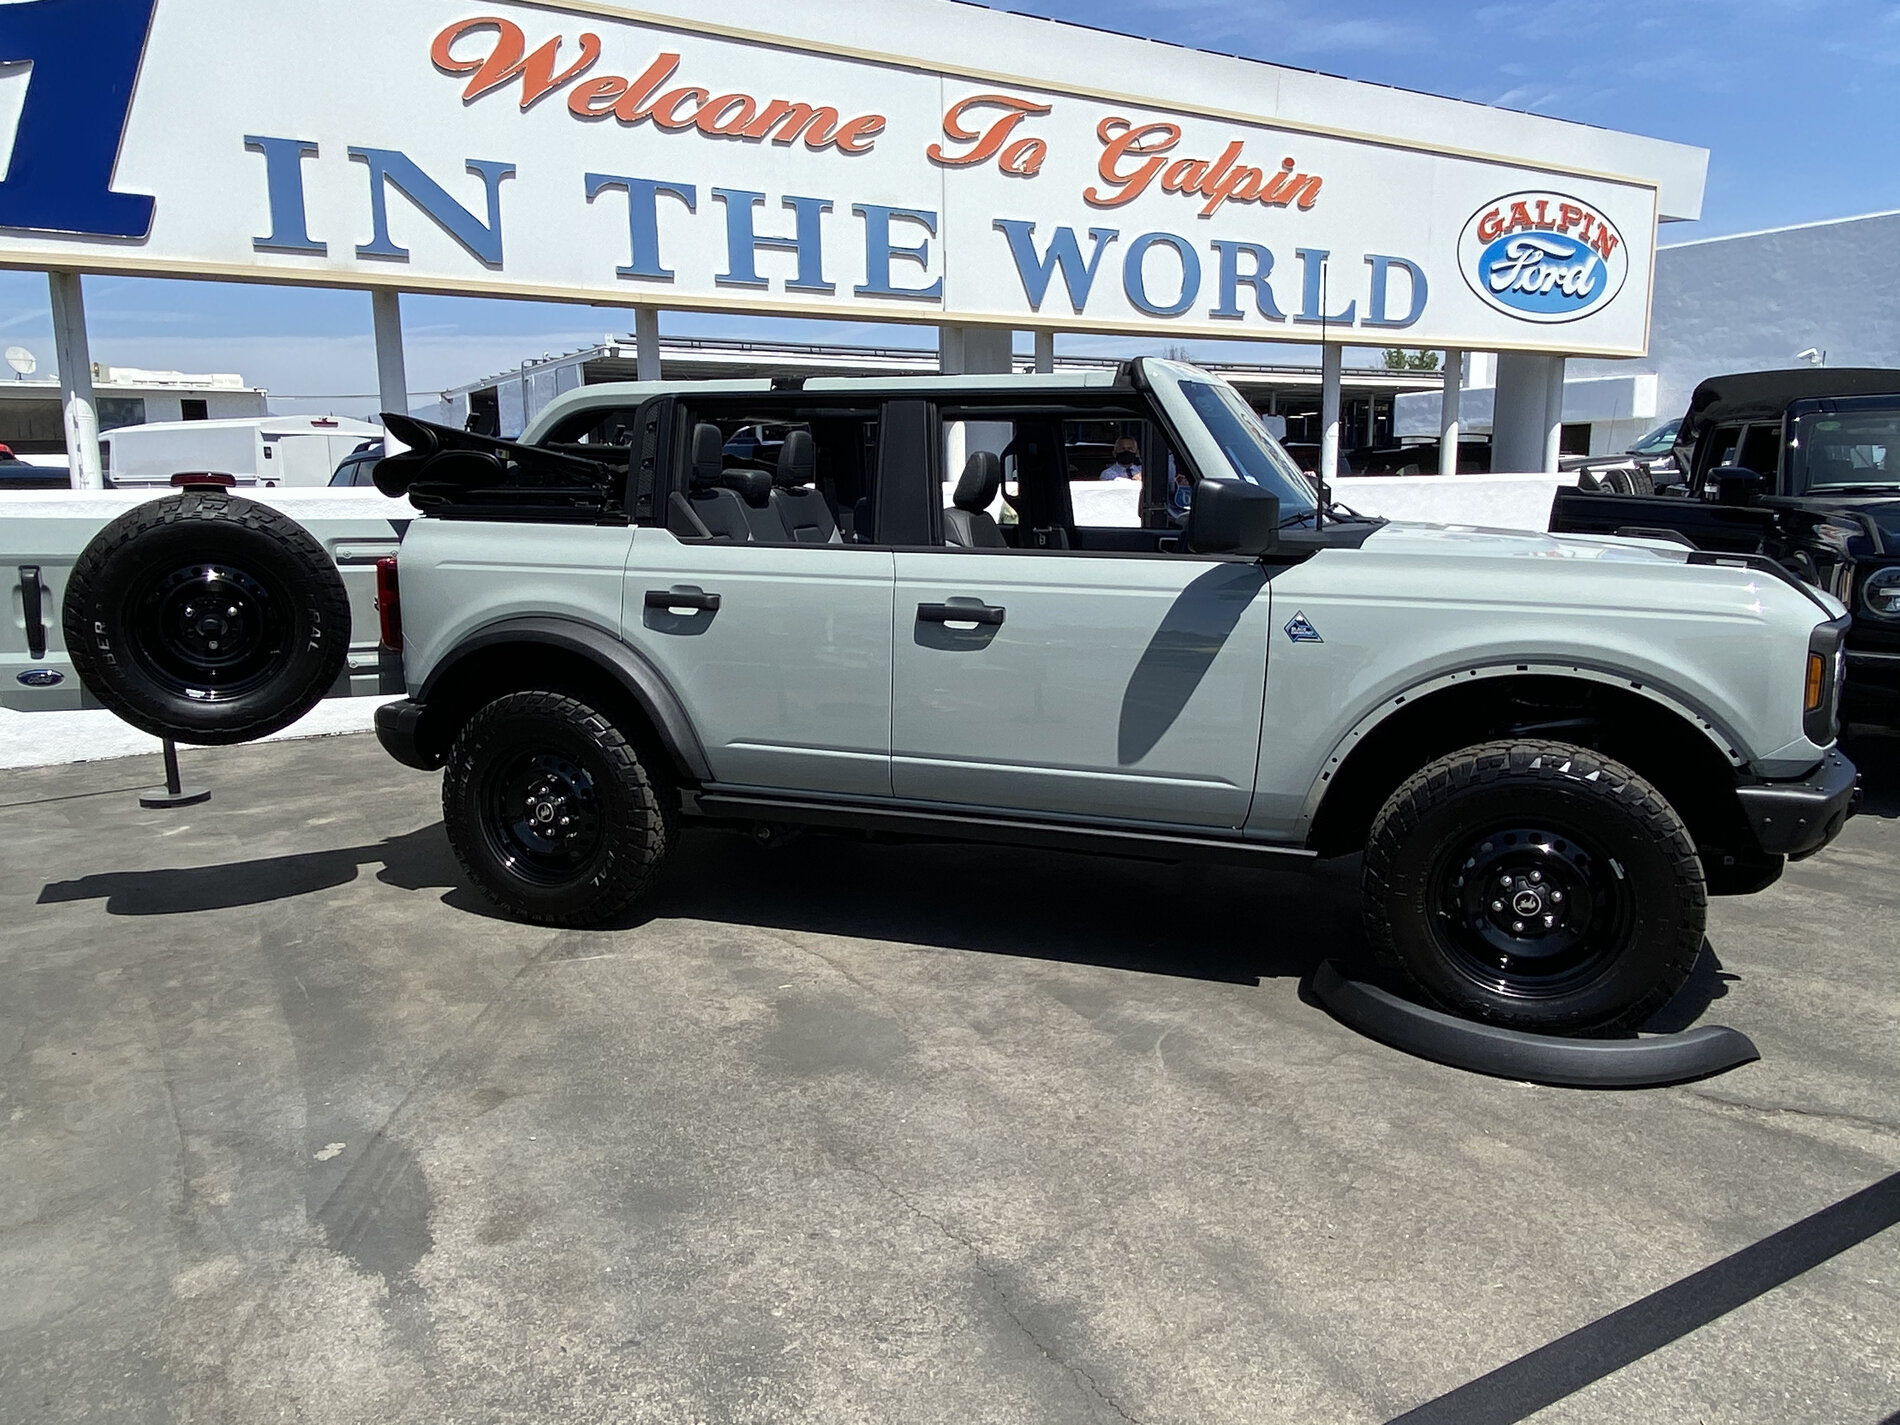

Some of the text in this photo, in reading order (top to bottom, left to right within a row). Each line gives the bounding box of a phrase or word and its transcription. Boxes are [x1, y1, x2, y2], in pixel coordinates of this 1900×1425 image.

[430, 17, 1325, 219] Welcome To Galpin
[243, 134, 517, 271] IN
[585, 172, 944, 299] THE
[993, 217, 1430, 327] WORLD
[1477, 199, 1619, 262] GALPIN
[1489, 237, 1601, 298] Ford
